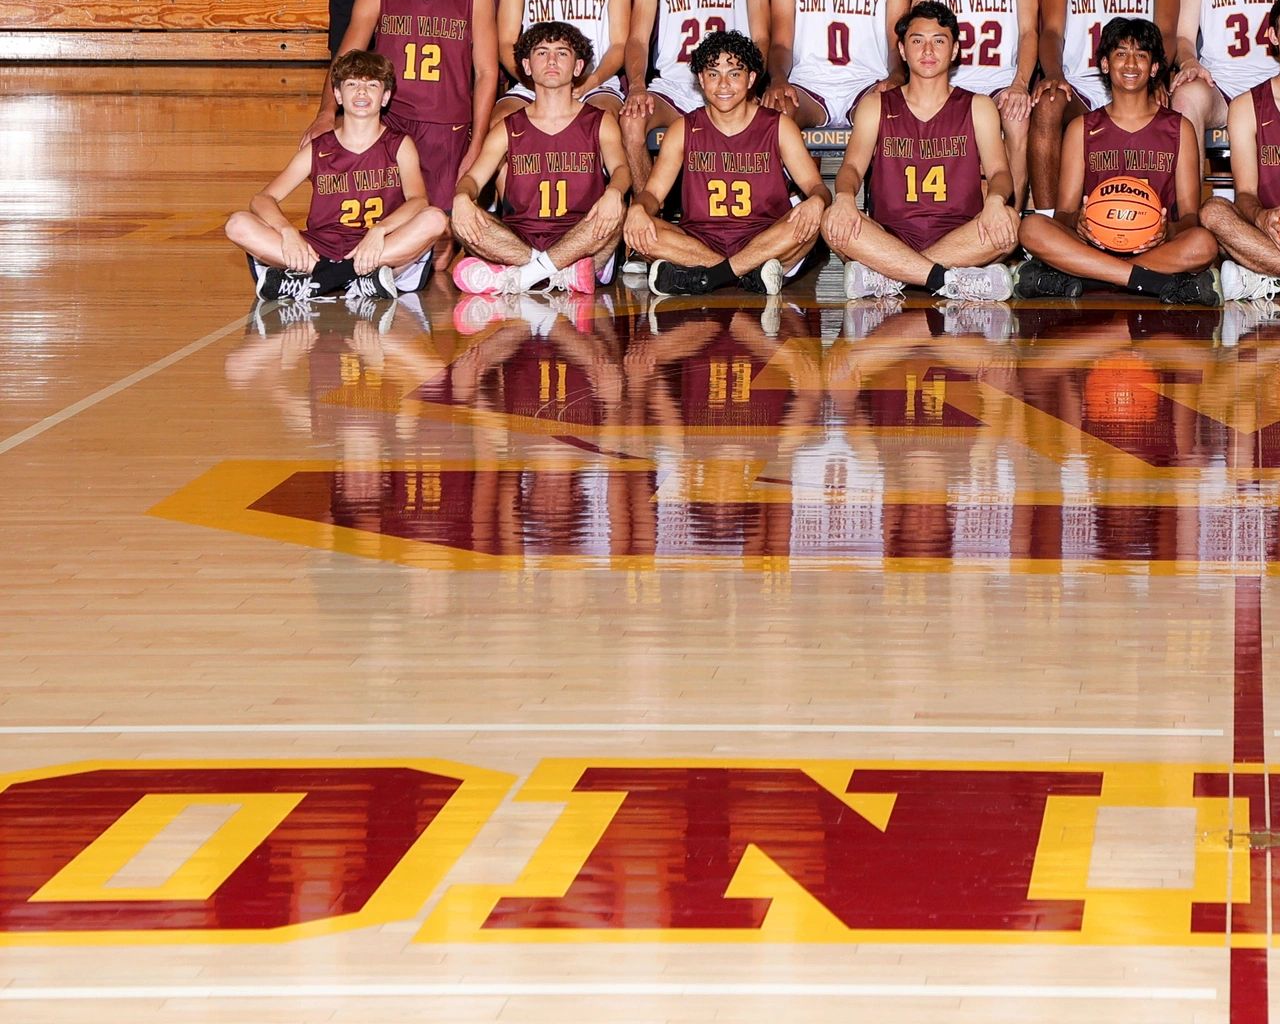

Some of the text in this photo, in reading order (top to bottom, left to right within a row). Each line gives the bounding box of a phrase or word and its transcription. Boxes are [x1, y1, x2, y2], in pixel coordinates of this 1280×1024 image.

[381, 14, 468, 41] SIMI VALLEY
[827, 22, 850, 65] 0
[958, 21, 1002, 67] 22
[404, 43, 441, 81] 12
[883, 135, 967, 159] SIMI VALLEY
[1088, 149, 1175, 173] SIMI VALLEY
[511, 152, 596, 175] SIMI VALLEY
[688, 151, 771, 173] SIMI VALLEY
[317, 166, 401, 194] SIMI VALLEY
[904, 165, 948, 202] 14
[1100, 183, 1151, 201] Wilson
[340, 197, 383, 228] 22
[538, 180, 568, 218] 11
[708, 180, 752, 217] 23
